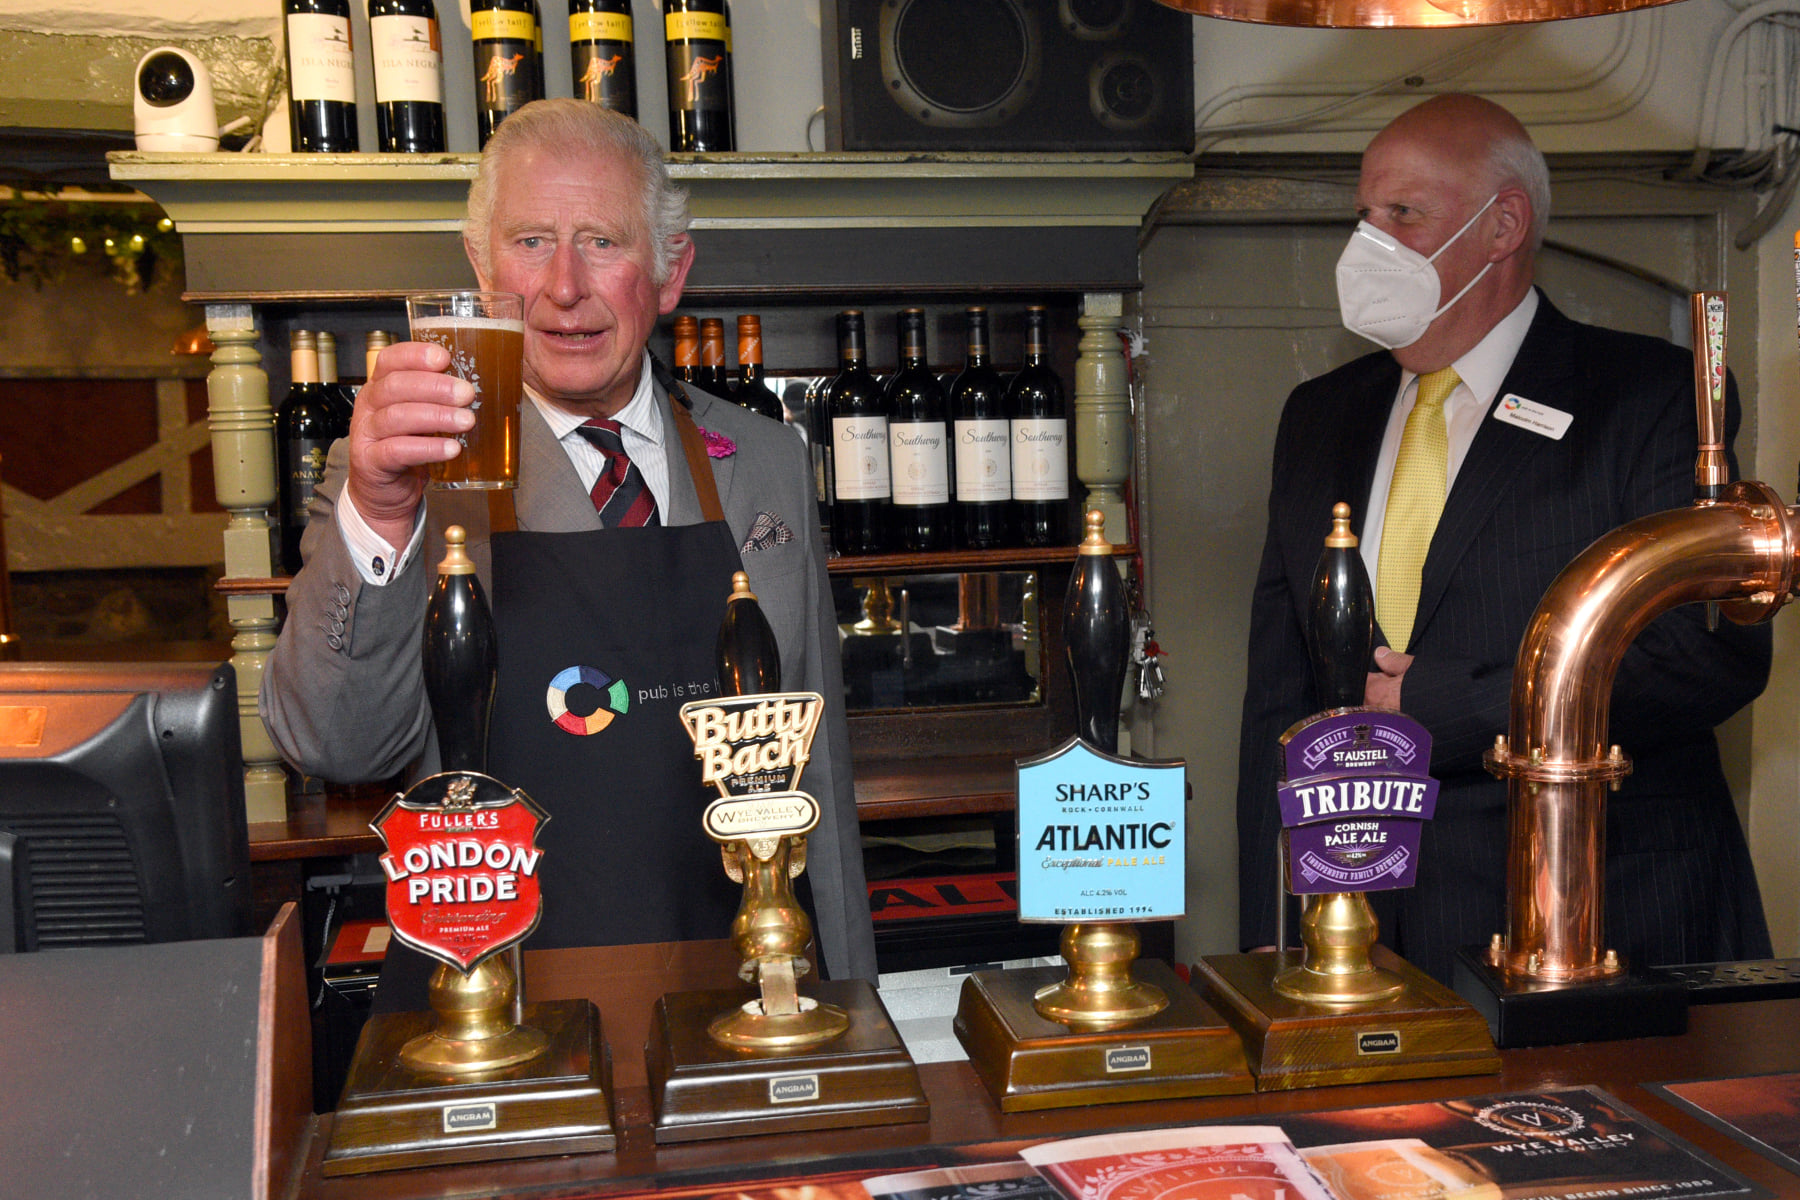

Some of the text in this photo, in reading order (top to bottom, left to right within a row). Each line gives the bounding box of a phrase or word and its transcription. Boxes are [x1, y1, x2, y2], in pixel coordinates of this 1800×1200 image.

[894, 431, 941, 450] Southway
[1016, 427, 1064, 446] Southway
[292, 471, 322, 479] ANAK
[638, 684, 668, 704] pub
[673, 683, 684, 697] is
[688, 681, 710, 695] the
[686, 699, 817, 749] Butty
[1314, 728, 1411, 753] QUALITY INNOVATION
[701, 731, 810, 781] Bach
[1345, 749, 1388, 761] AUSTELL
[731, 774, 786, 787] PREMIUM
[748, 784, 771, 793] ALE
[1055, 781, 1151, 802] SHARP'S
[1295, 780, 1427, 818] TRIBUTE
[420, 812, 499, 828] FULLER'S
[1335, 822, 1379, 832] CORNISH
[1035, 822, 1172, 851] ATLANTIC
[1324, 832, 1388, 847] PALE ALE
[381, 841, 540, 882] LONDON
[1041, 855, 1166, 871] Exceptional PALE ALE
[1306, 851, 1404, 880] INDEPENDENT FAMILY BREWERS
[408, 875, 518, 904] PRIDE
[1096, 888, 1112, 896] 4.2%
[1114, 888, 1128, 896] VOL
[421, 908, 508, 924] Outstanding
[1055, 907, 1125, 915] ESTABLISHED
[1362, 1038, 1396, 1047] ANGRAM
[1111, 1054, 1146, 1064] ANGRAM
[775, 1083, 813, 1094] ANGRAM
[450, 1111, 490, 1123] ANGRAM
[1492, 1132, 1635, 1153] WYE VALLEY
[1523, 1141, 1629, 1157] BREWERY
[1564, 1189, 1619, 1200] BEERS
[1622, 1184, 1672, 1194] SINCE
